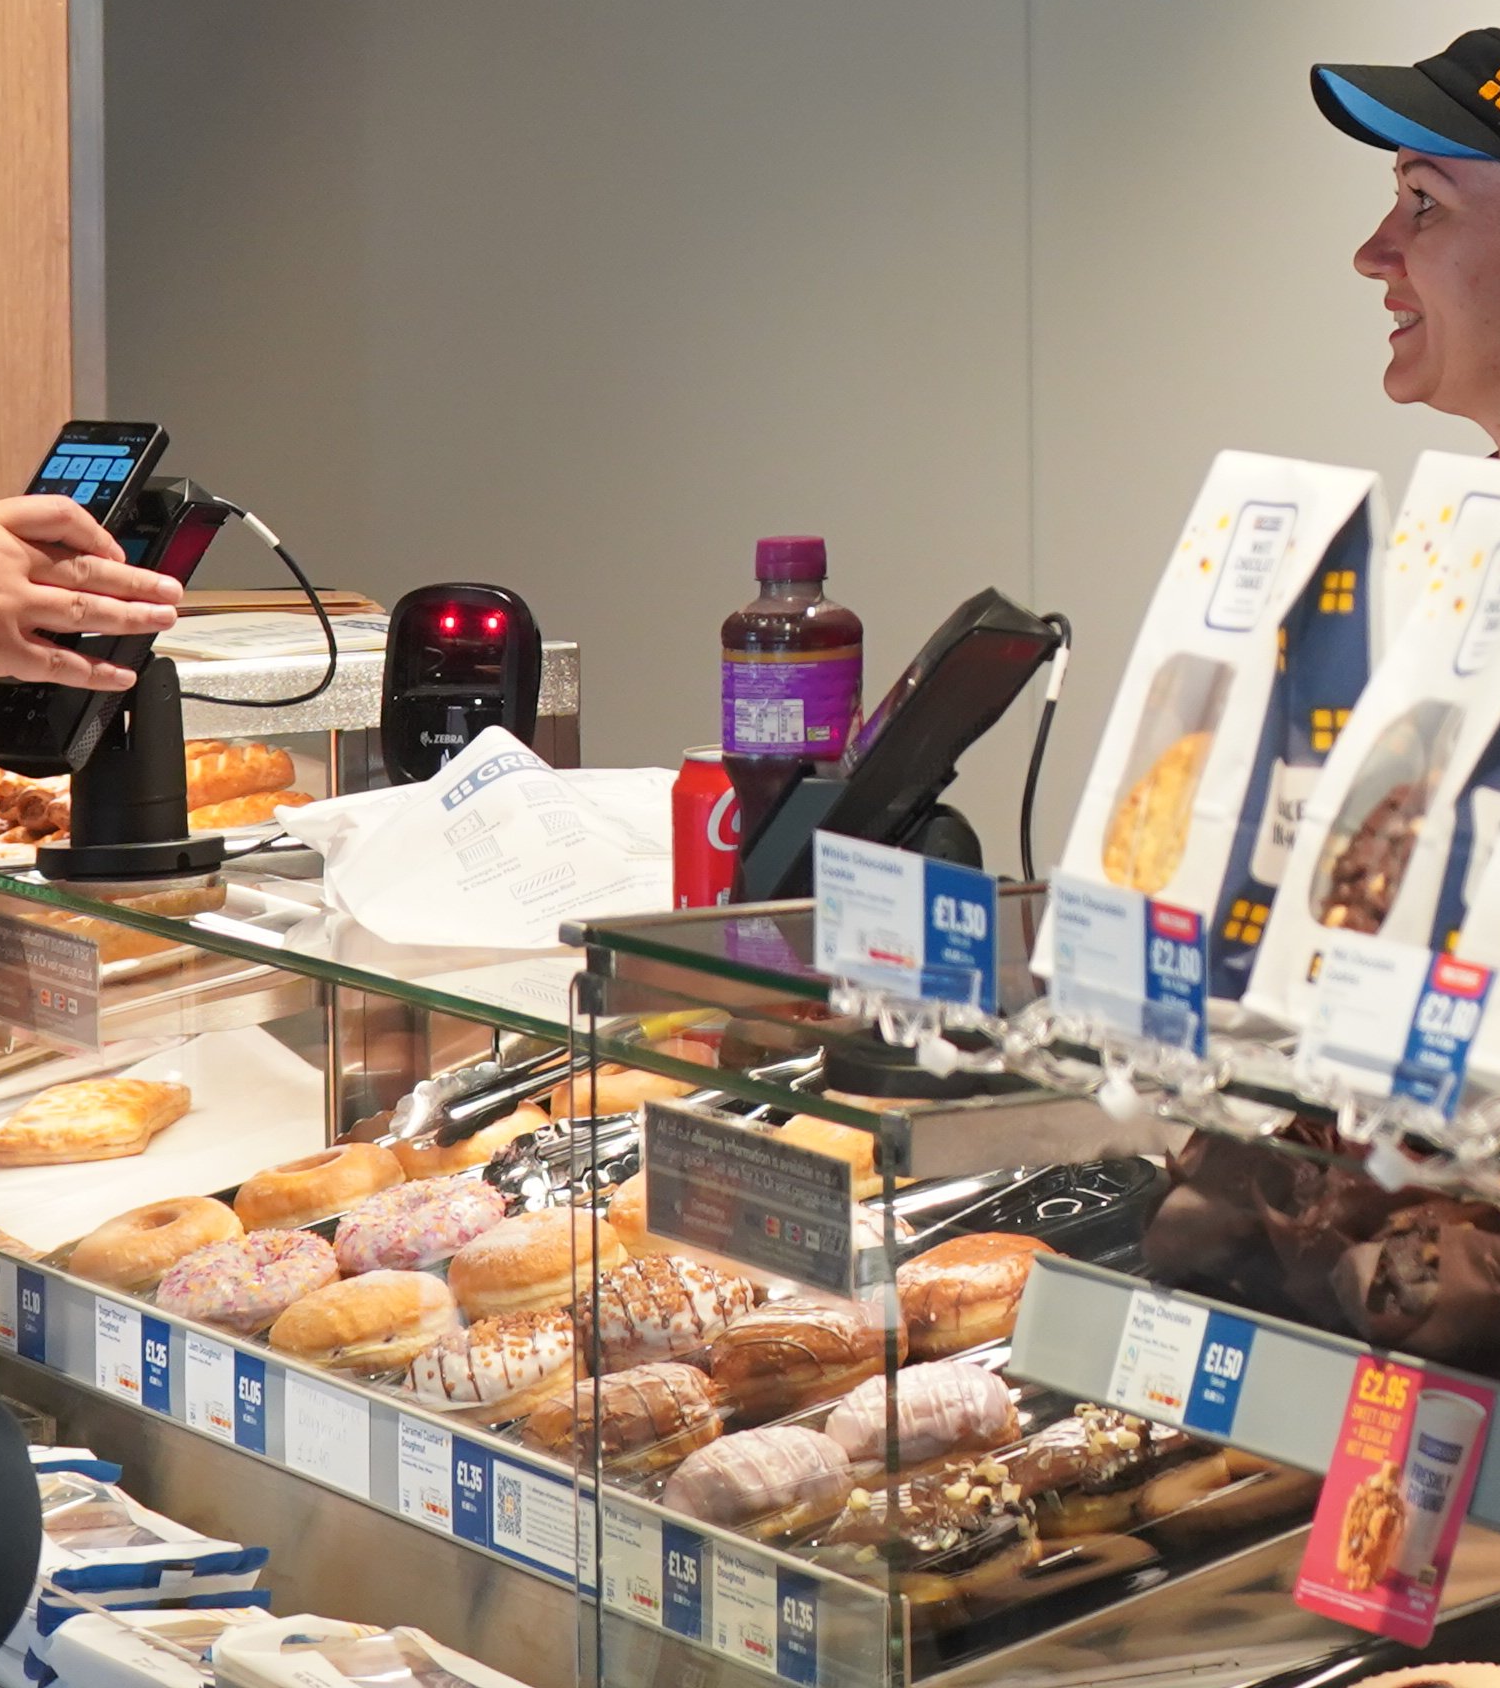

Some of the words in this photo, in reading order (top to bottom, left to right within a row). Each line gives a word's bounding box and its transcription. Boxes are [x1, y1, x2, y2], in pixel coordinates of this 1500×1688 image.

[433, 733, 464, 745] ZEBRA
[820, 844, 850, 862] White
[852, 851, 904, 876] Chocolate
[820, 862, 855, 882] Cookie
[933, 895, 987, 941] £1.30
[691, 1126, 723, 1154] allergen
[724, 1138, 772, 1166] information
[22, 1288, 41, 1315] £1.10
[1137, 1299, 1156, 1316] Triple
[1156, 1305, 1192, 1327] Chocolate
[1132, 1316, 1154, 1331] Muffin
[145, 1339, 168, 1369] £1.25
[199, 1343, 222, 1362] Doughnut
[1204, 1341, 1244, 1381] £1.50
[238, 1375, 262, 1405] £1.05
[1358, 1368, 1411, 1410] £2.95
[401, 1422, 424, 1441] Caramel
[424, 1427, 445, 1446] Custard
[402, 1436, 426, 1455] Doughnut
[456, 1460, 483, 1493] £1.35
[668, 1550, 697, 1586] £1.35
[717, 1565, 746, 1587] Doughnut
[734, 1553, 767, 1579] Chocolate
[782, 1595, 814, 1633] £1.35
